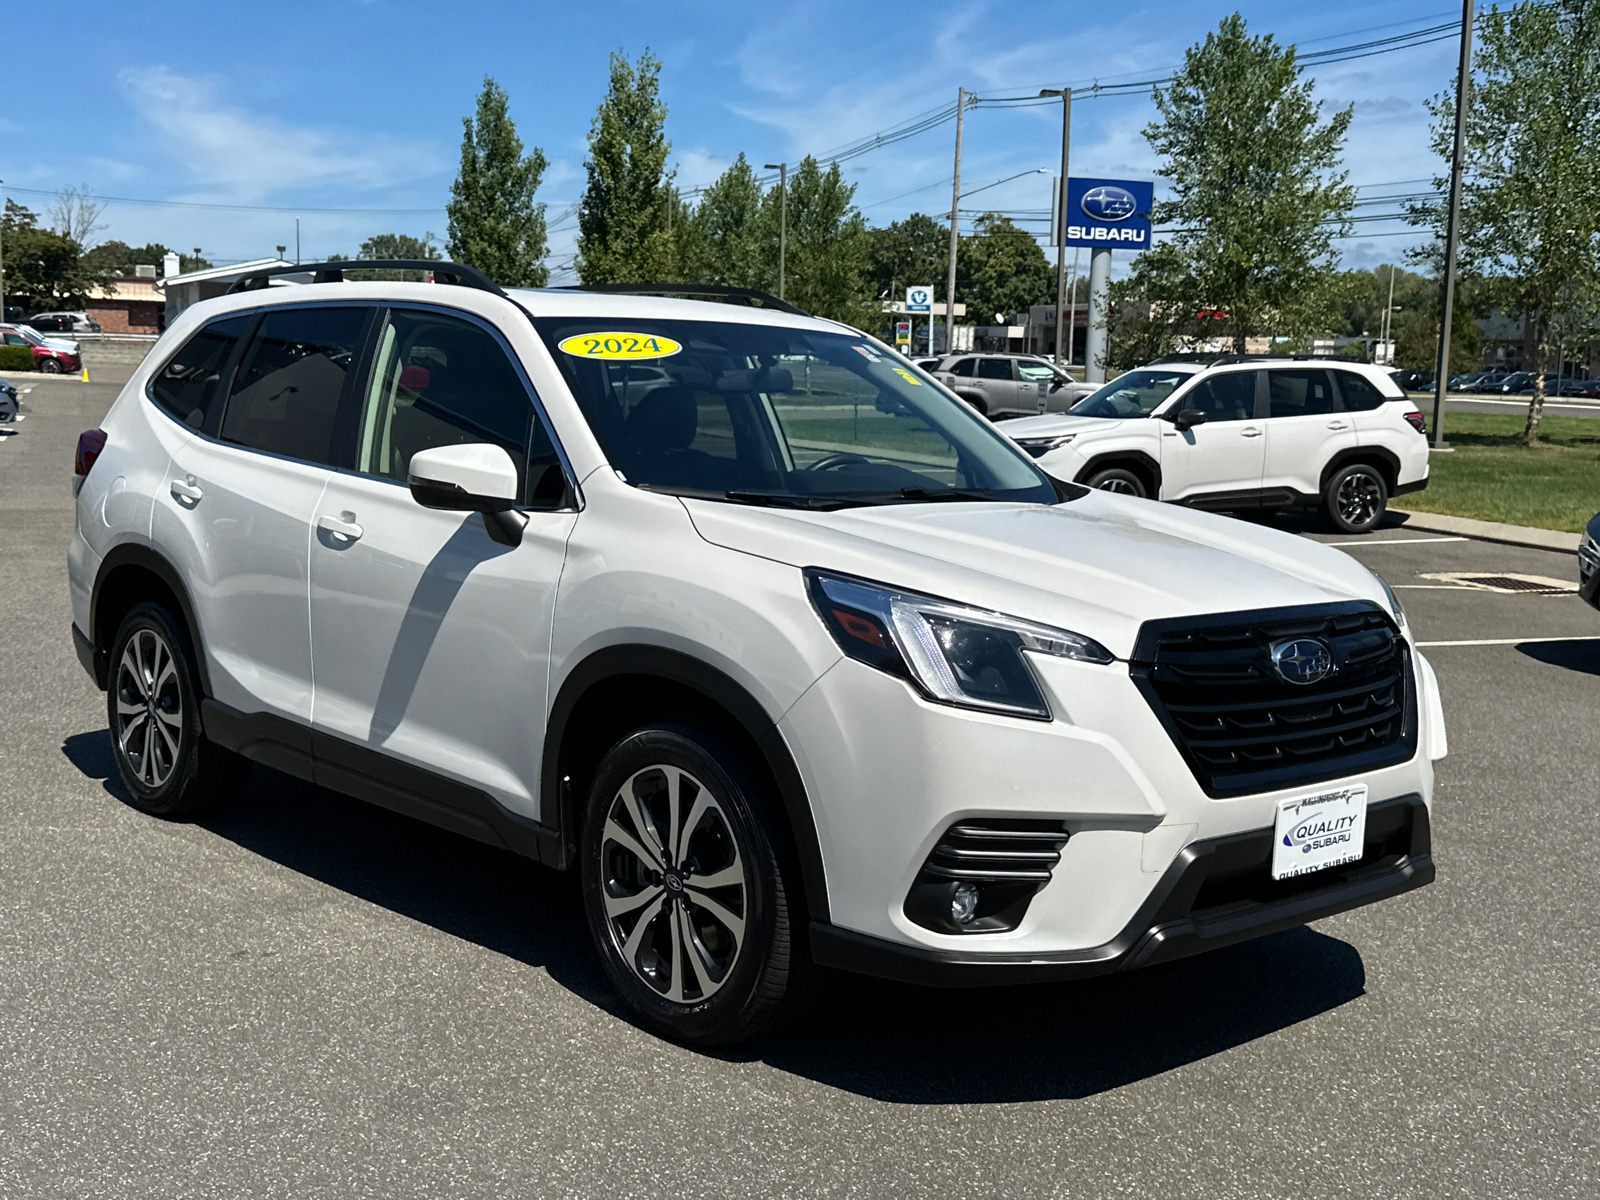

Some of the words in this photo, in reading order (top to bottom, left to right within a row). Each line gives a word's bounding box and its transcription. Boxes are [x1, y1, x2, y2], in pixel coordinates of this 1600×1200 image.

[1067, 226, 1145, 242] SUBARU
[583, 338, 662, 354] 2024
[1296, 815, 1357, 839] QUALITY
[1312, 833, 1351, 849] SUBARU
[1280, 864, 1320, 880] QUALITY
[1323, 854, 1360, 869] SUBARU
